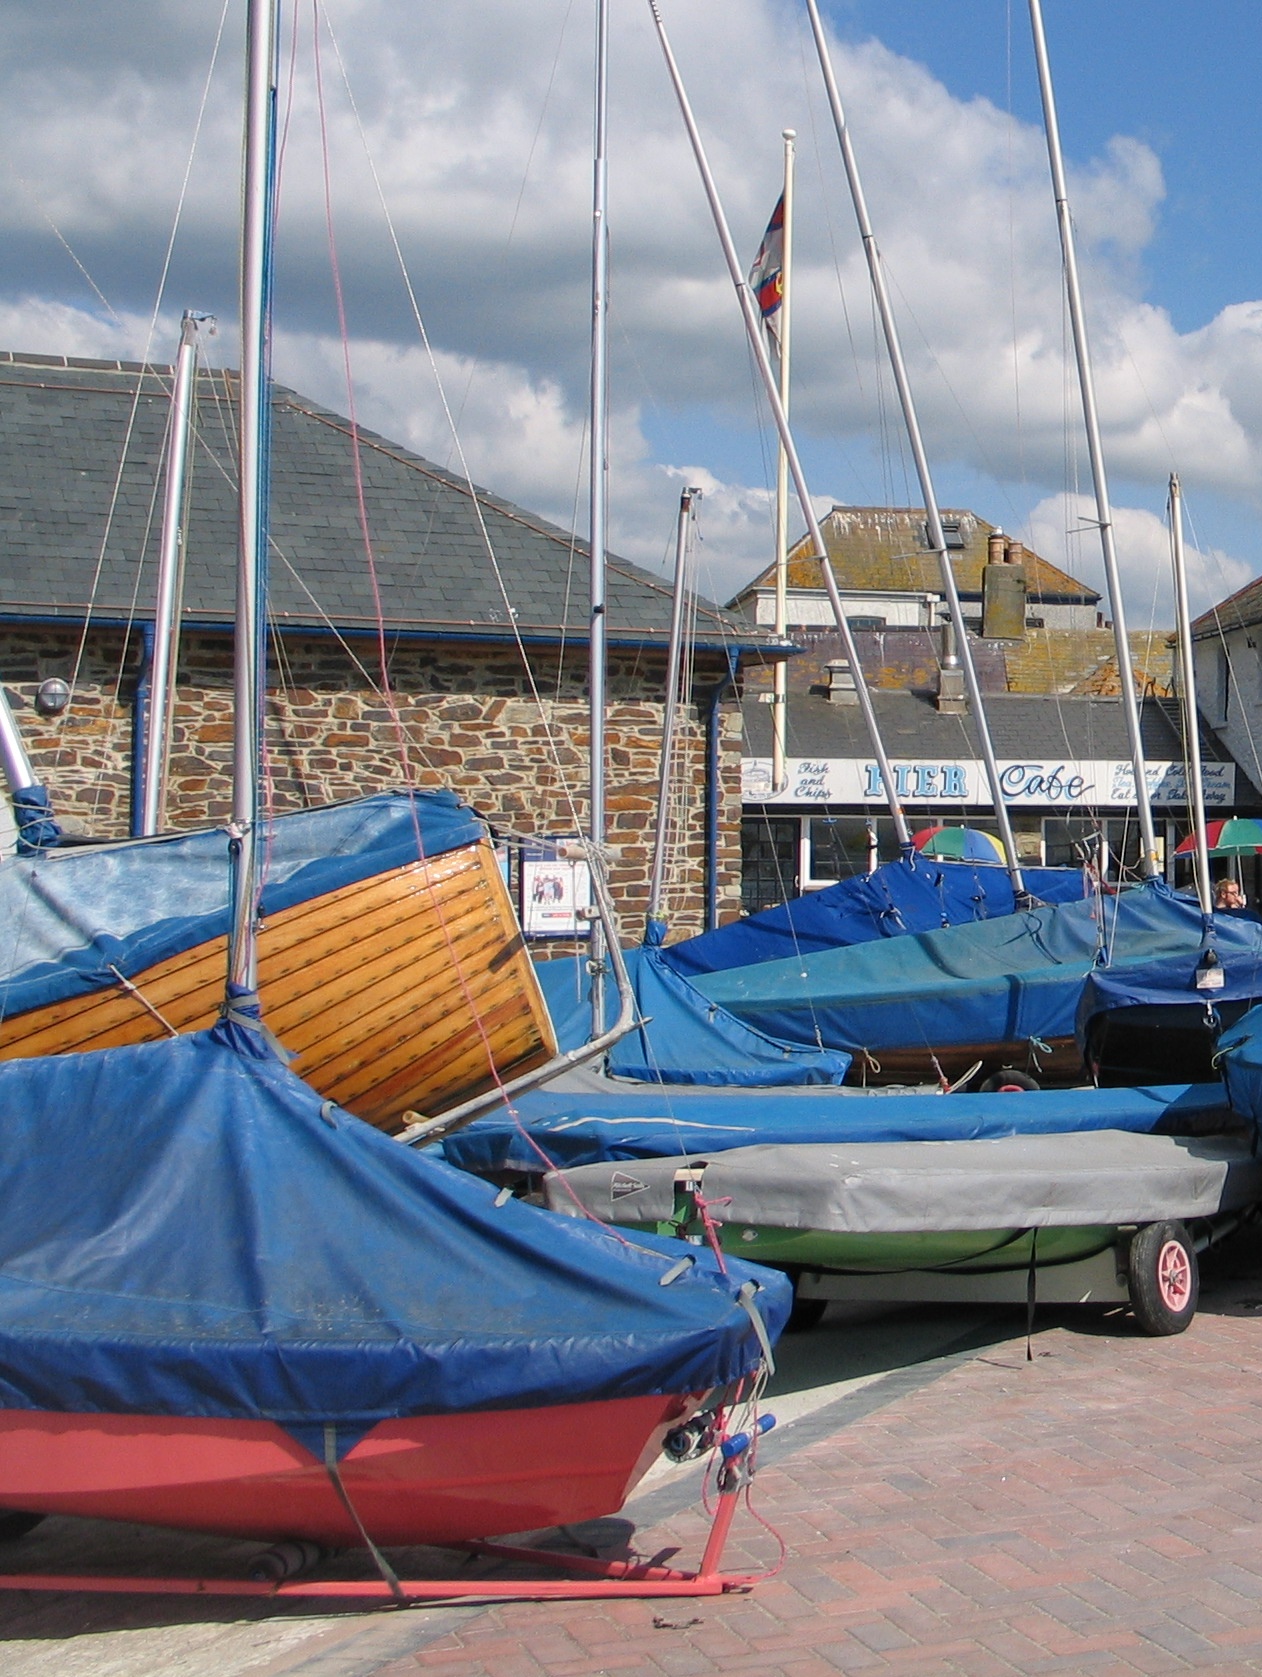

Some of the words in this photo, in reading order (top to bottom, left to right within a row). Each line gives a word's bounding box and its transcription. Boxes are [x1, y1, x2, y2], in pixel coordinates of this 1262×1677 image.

[797, 762, 829, 775] Fish
[1114, 763, 1136, 776] Ho
[799, 775, 825, 786] and
[793, 786, 832, 801] Chips
